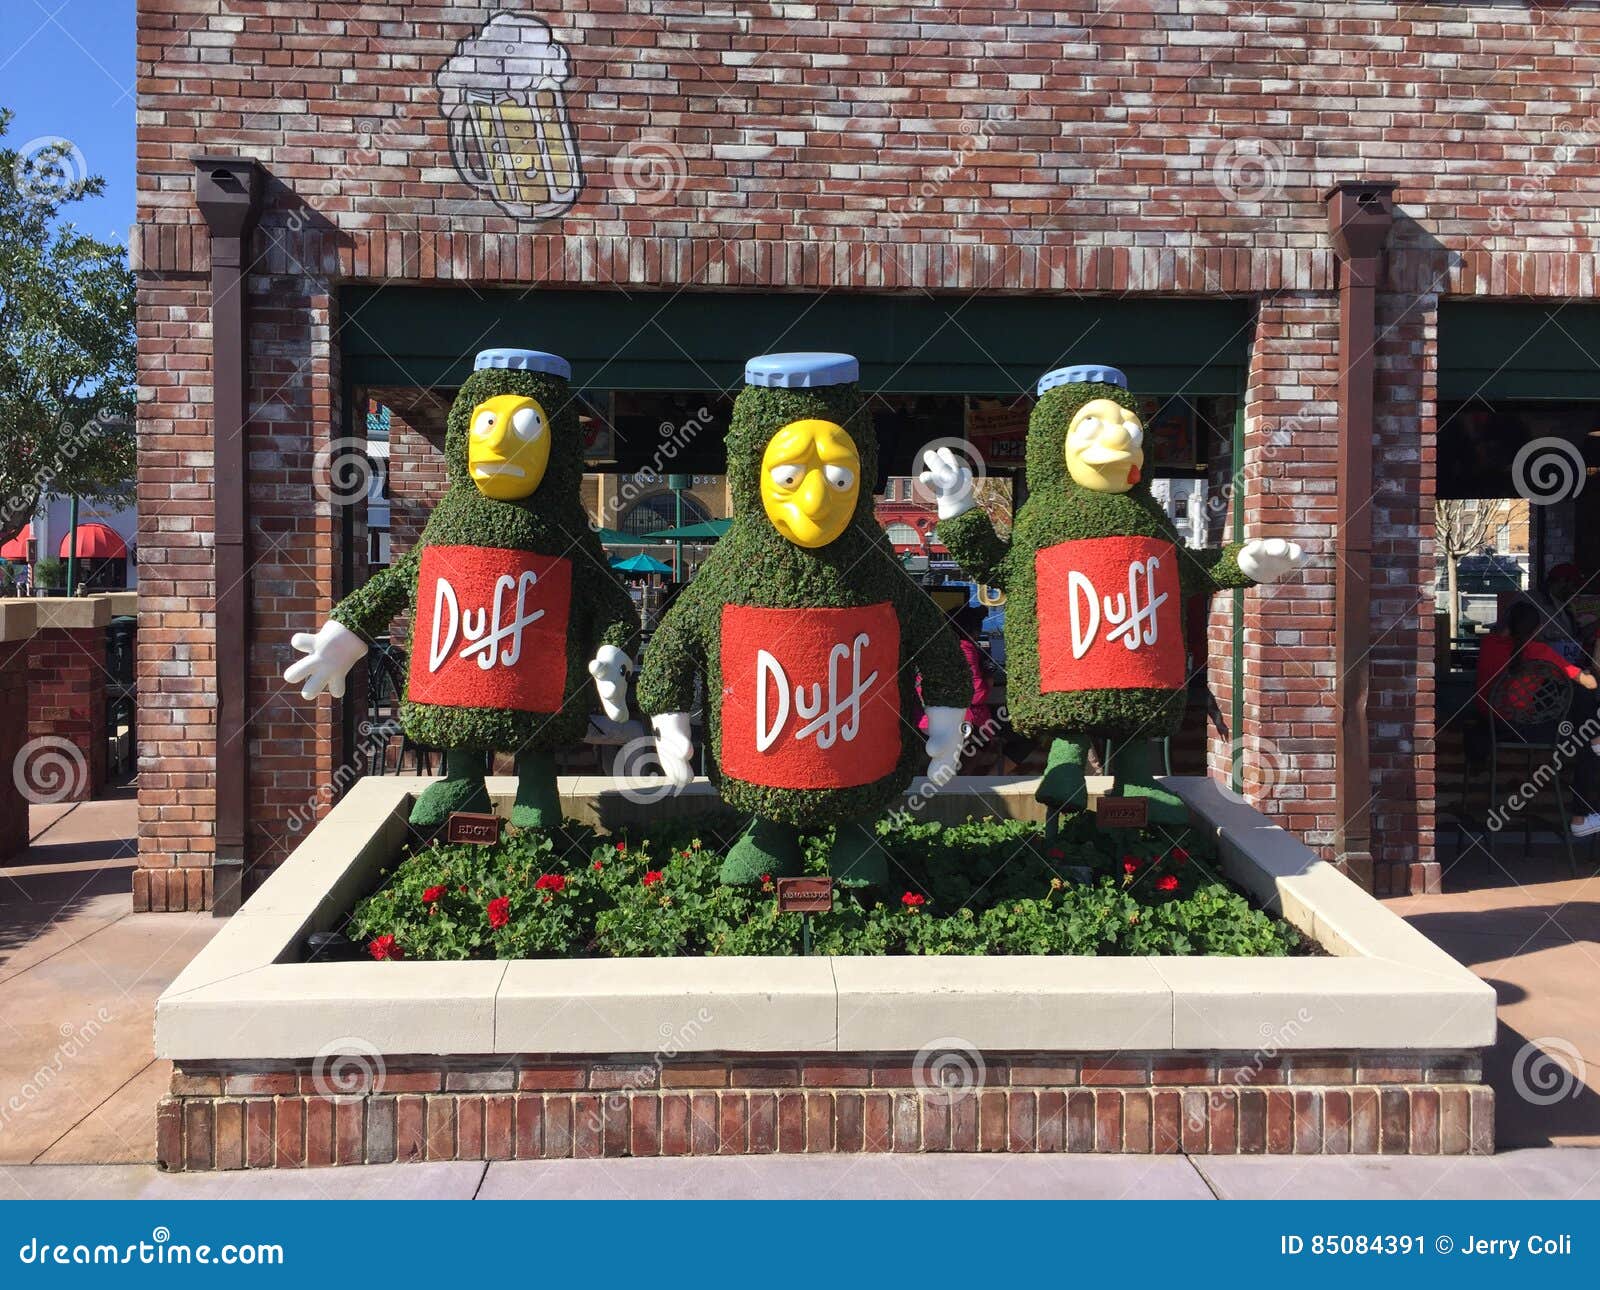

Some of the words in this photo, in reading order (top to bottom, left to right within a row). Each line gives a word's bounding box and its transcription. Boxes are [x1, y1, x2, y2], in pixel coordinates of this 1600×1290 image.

[429, 569, 545, 674] Duff
[1067, 556, 1169, 660] Duff
[755, 632, 879, 753] Duff
[458, 824, 490, 836] EDGY
